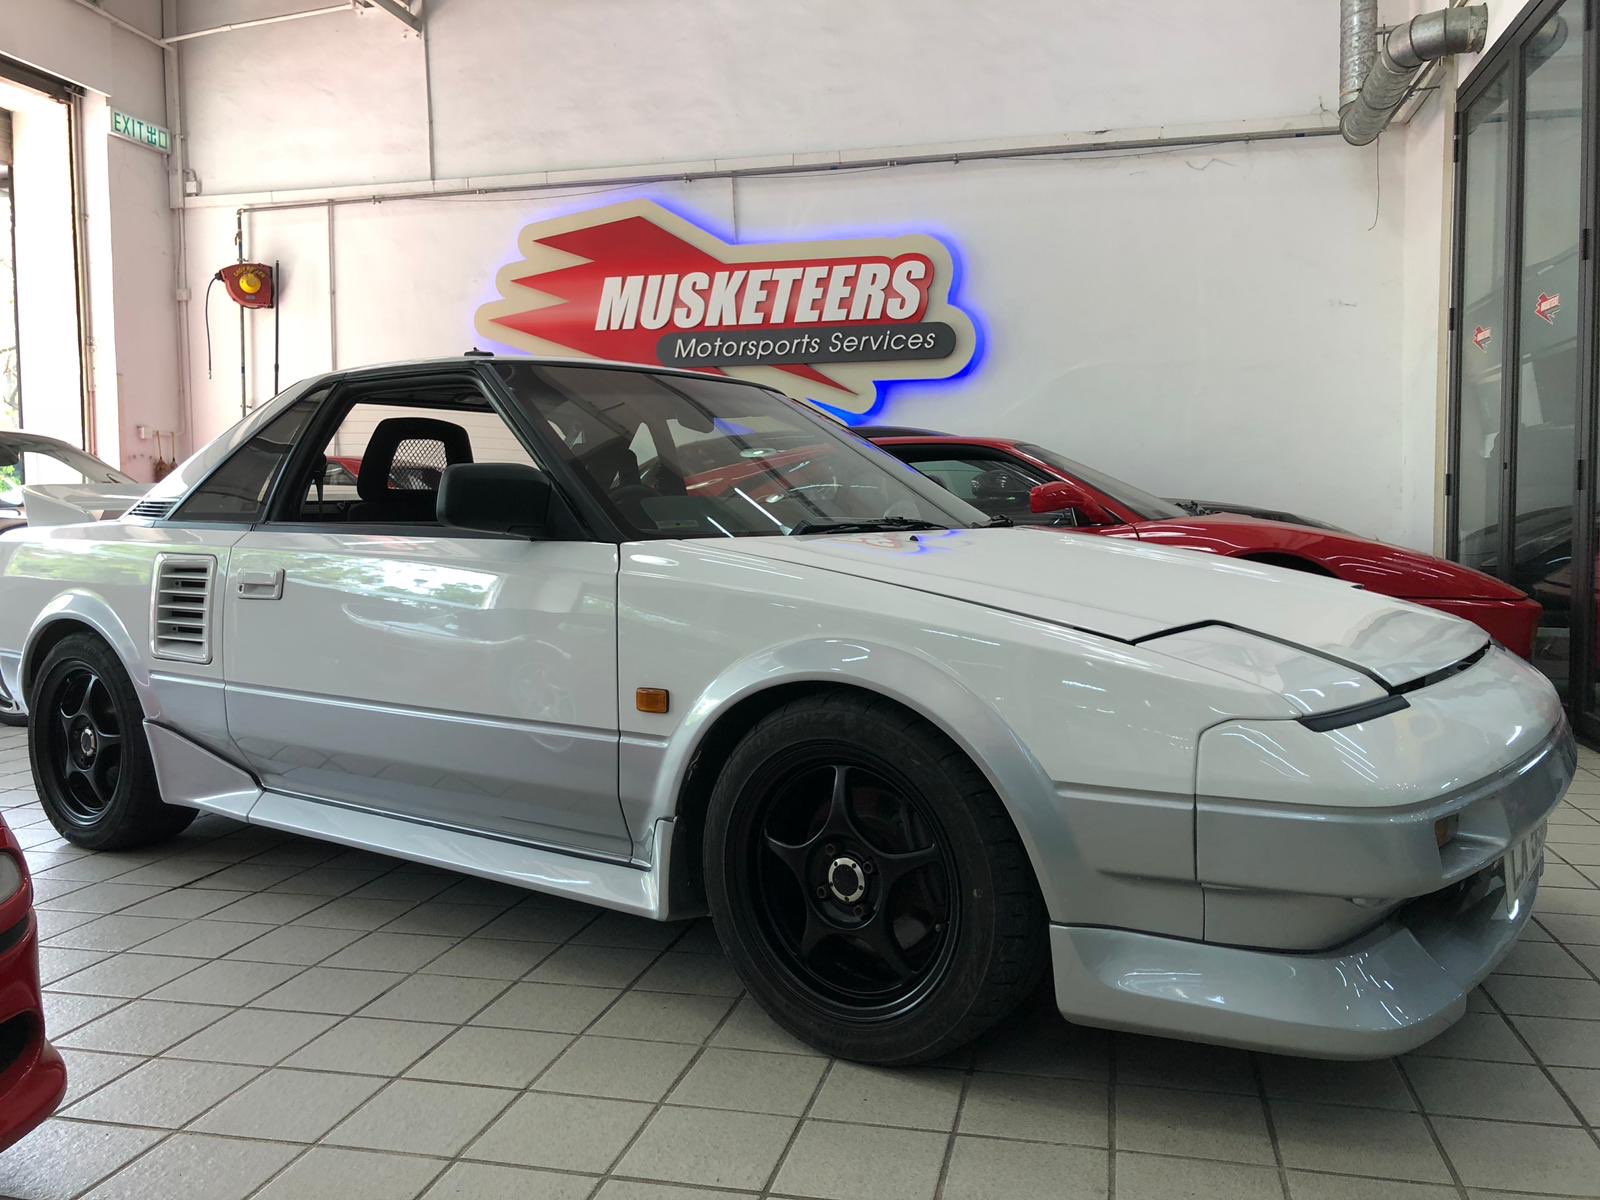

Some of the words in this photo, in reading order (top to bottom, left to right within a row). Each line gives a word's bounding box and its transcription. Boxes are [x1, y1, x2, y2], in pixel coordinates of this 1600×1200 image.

[114, 112, 144, 140] EXIT
[146, 125, 168, 149] 出口
[594, 260, 926, 332] MUSKETEERS
[673, 333, 820, 360] Motorsports
[828, 330, 937, 353] Services
